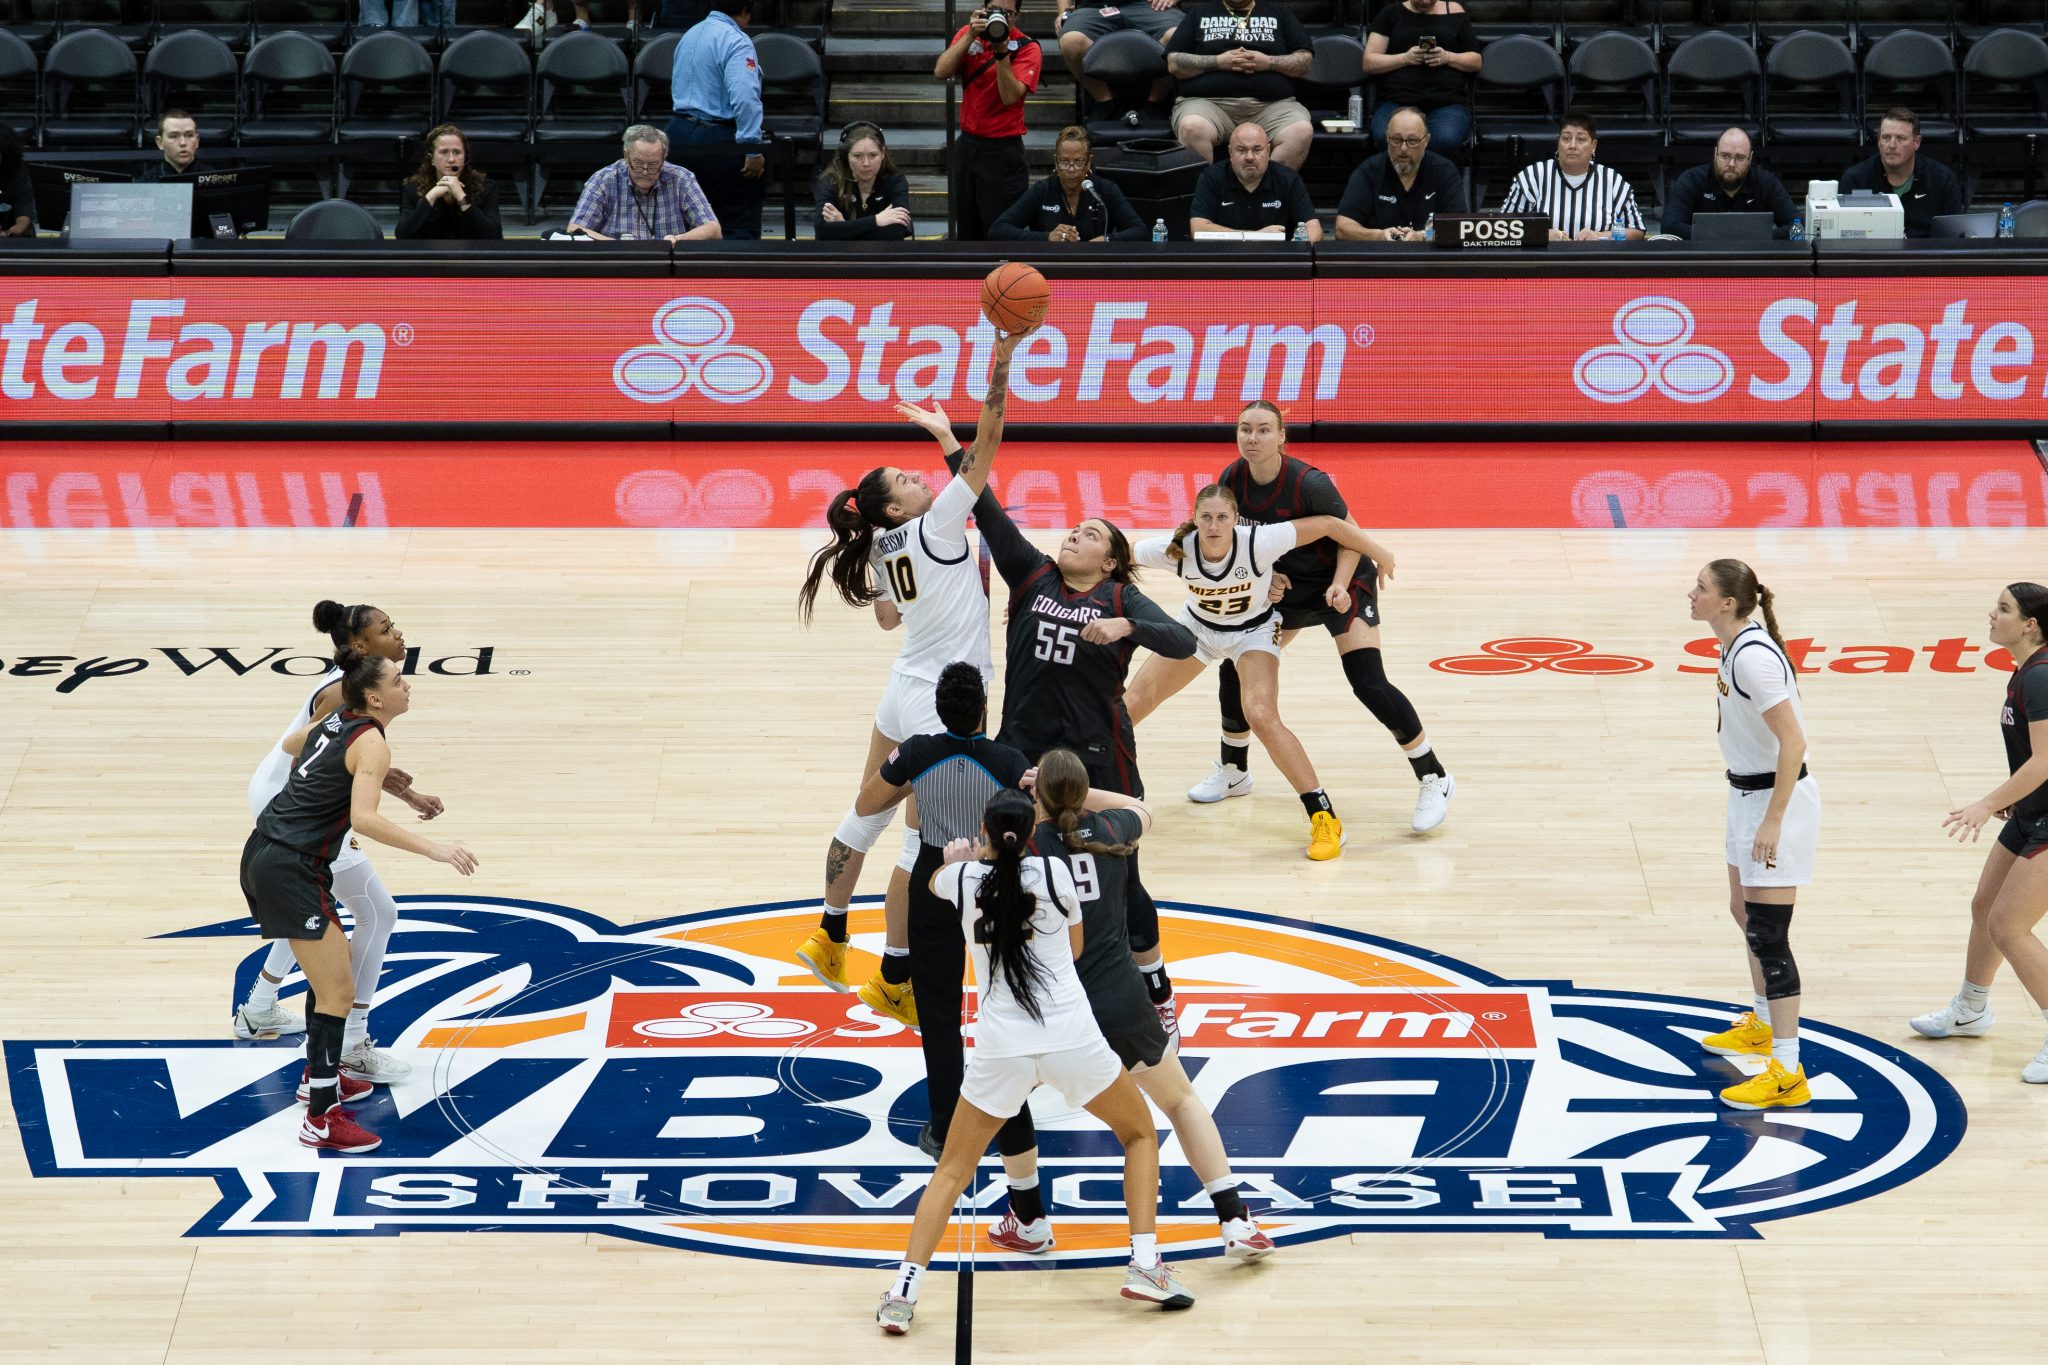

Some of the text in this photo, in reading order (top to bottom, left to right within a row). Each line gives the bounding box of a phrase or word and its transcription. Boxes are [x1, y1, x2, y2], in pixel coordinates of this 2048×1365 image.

[1250, 16, 1278, 29] DAD
[1203, 33, 1275, 42] BEST MOVES
[1460, 220, 1525, 240] POSS
[884, 555, 918, 604] 10
[1188, 582, 1252, 597] MIZZOU
[1031, 594, 1102, 624] COUGARS
[1198, 596, 1252, 615] 23
[1034, 620, 1079, 665] 55
[297, 733, 330, 778] 2
[365, 1172, 1583, 1211] SHOWCASE
